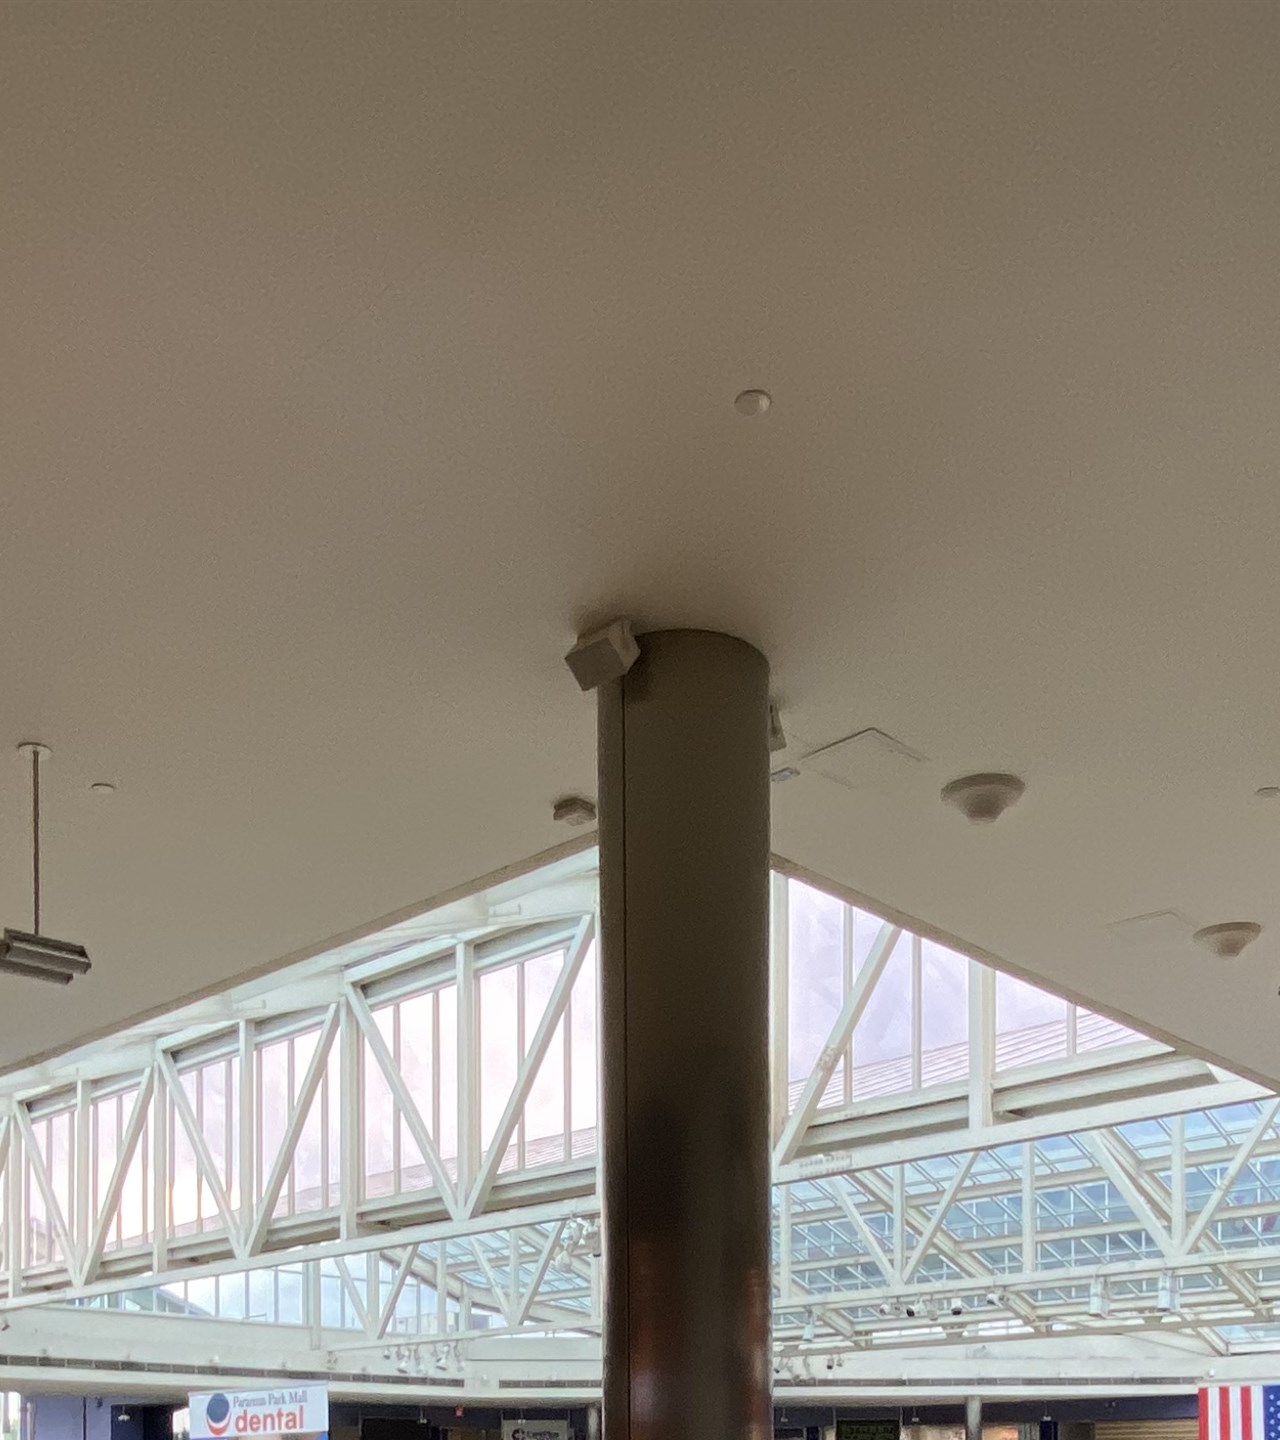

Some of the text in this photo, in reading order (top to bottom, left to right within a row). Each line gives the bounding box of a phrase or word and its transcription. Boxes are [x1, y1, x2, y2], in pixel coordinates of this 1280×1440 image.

[268, 1392, 287, 1406] Park
[288, 1390, 308, 1403] Mall
[235, 1404, 304, 1433] dental
